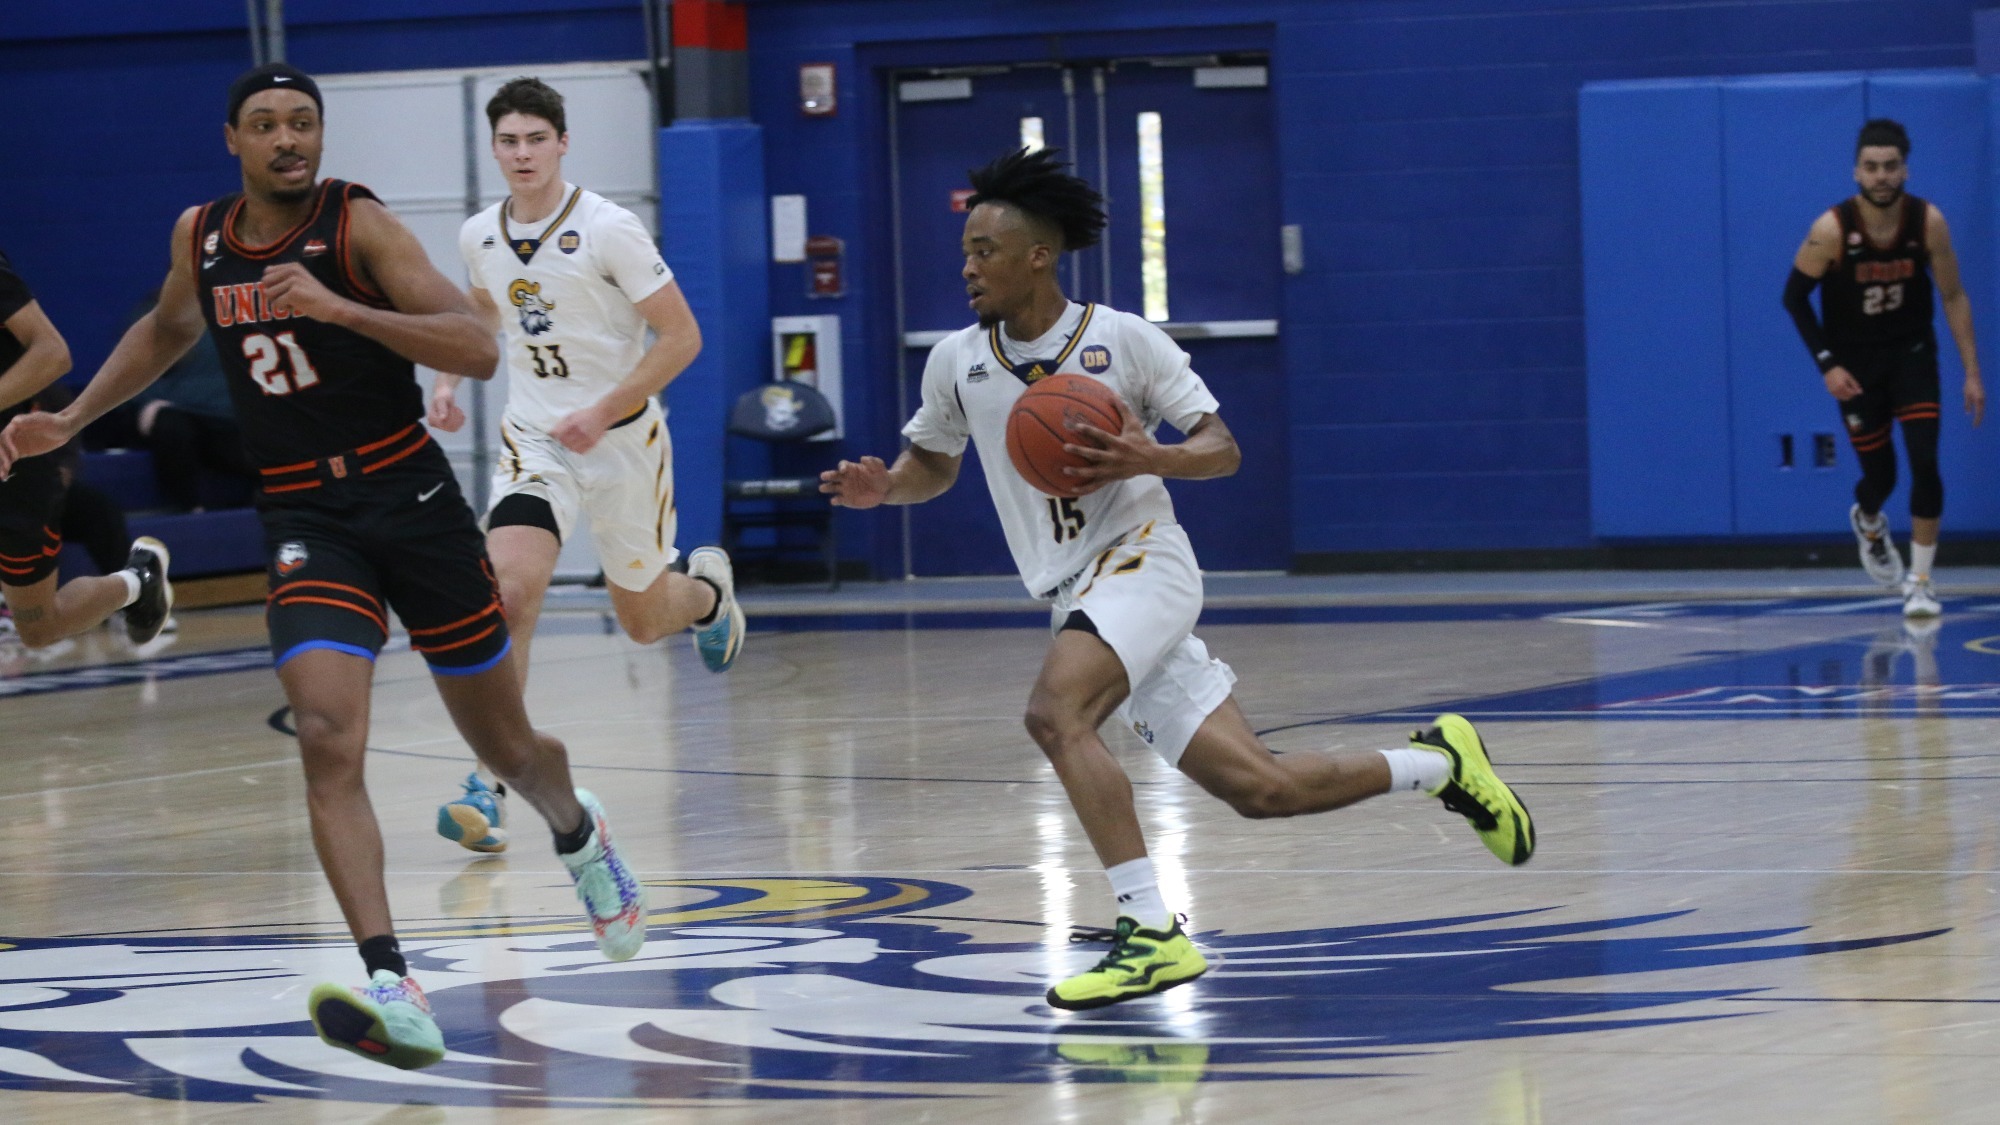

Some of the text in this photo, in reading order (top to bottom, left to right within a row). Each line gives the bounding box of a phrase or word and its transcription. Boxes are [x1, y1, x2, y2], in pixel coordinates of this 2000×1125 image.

[212, 281, 304, 327] UNI
[1863, 283, 1904, 315] 23
[242, 330, 320, 396] 21
[525, 344, 569, 378] 33
[1083, 350, 1109, 368] DR
[1045, 496, 1087, 545] 15
